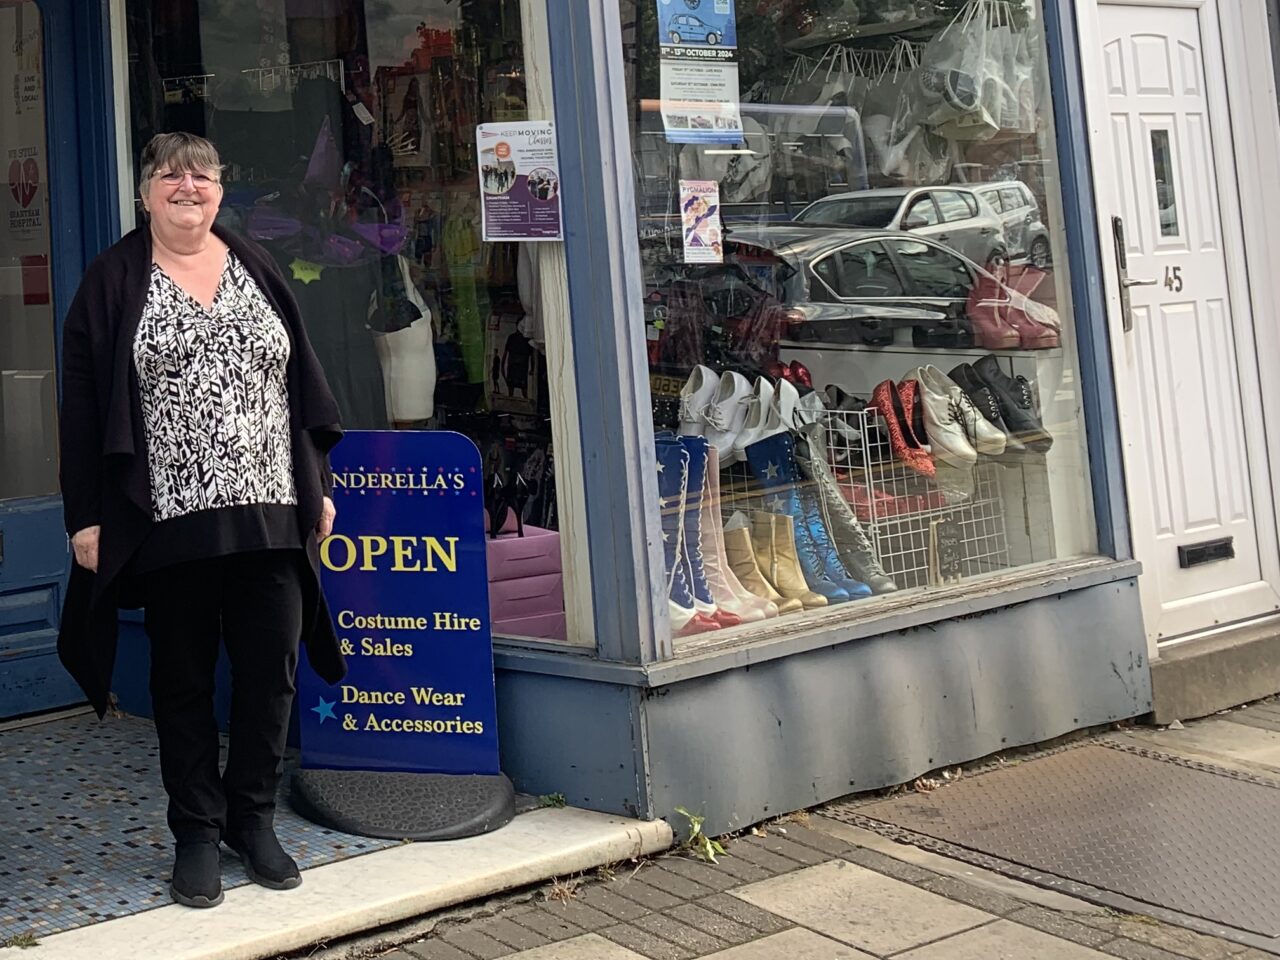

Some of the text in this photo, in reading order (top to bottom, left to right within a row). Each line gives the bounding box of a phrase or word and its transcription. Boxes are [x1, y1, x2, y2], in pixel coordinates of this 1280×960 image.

[686, 48, 717, 57] OCTOBER
[717, 50, 734, 58] 2024
[1164, 265, 1183, 293] 45
[331, 472, 465, 490] NDERELLA'S
[320, 534, 460, 572] OPEN
[337, 610, 482, 631] Costume Hire
[339, 637, 414, 657] & Sales
[340, 685, 466, 706] Dance Wear
[342, 712, 484, 734] & Accessories
